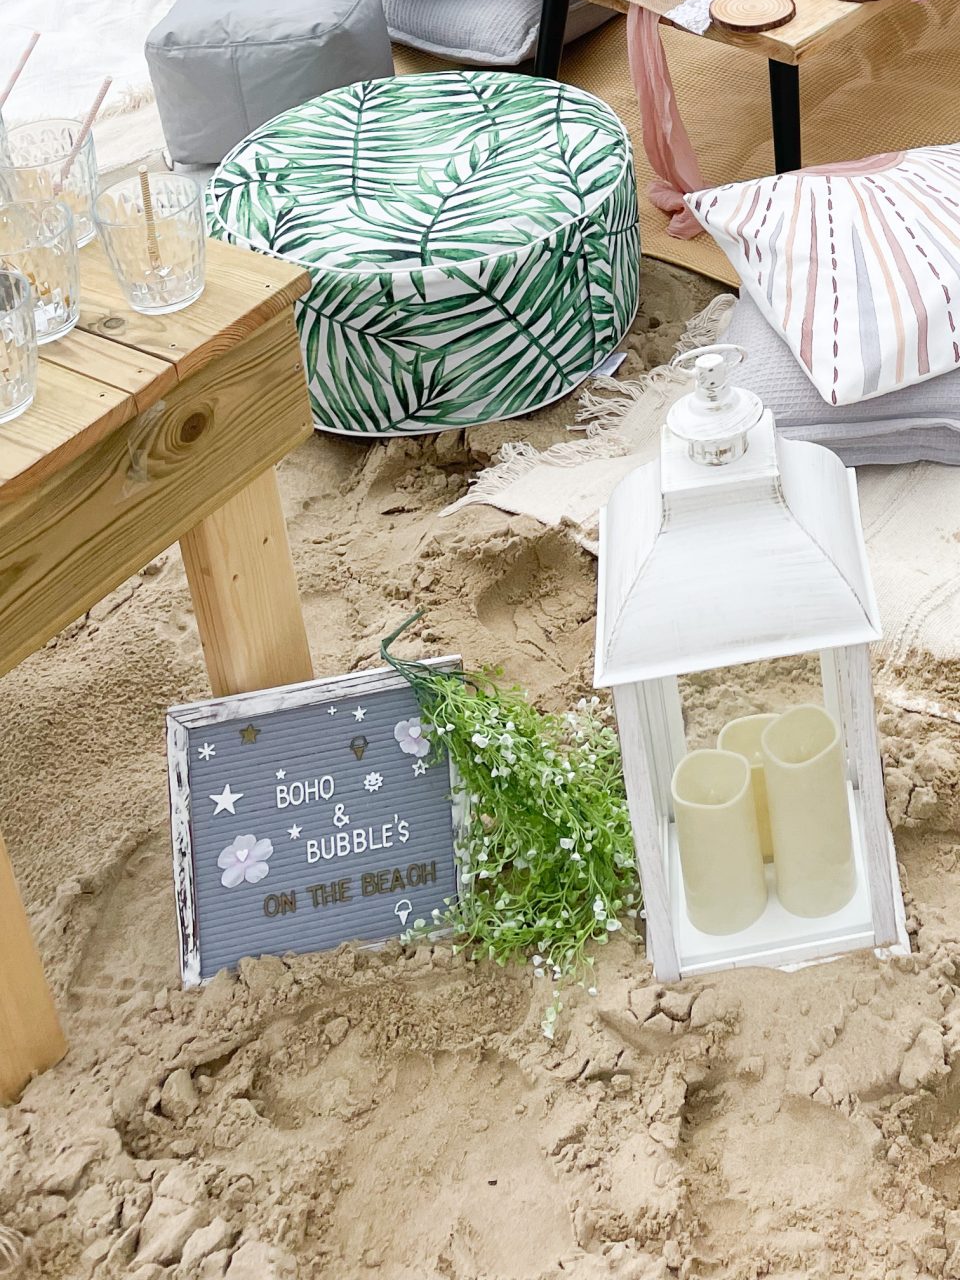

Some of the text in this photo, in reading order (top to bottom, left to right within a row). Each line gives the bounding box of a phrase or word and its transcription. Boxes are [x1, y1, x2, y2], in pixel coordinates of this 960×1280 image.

[276, 775, 335, 809] BOHO
[333, 803, 350, 828] &
[263, 890, 297, 918] ON
[306, 877, 353, 908] THE
